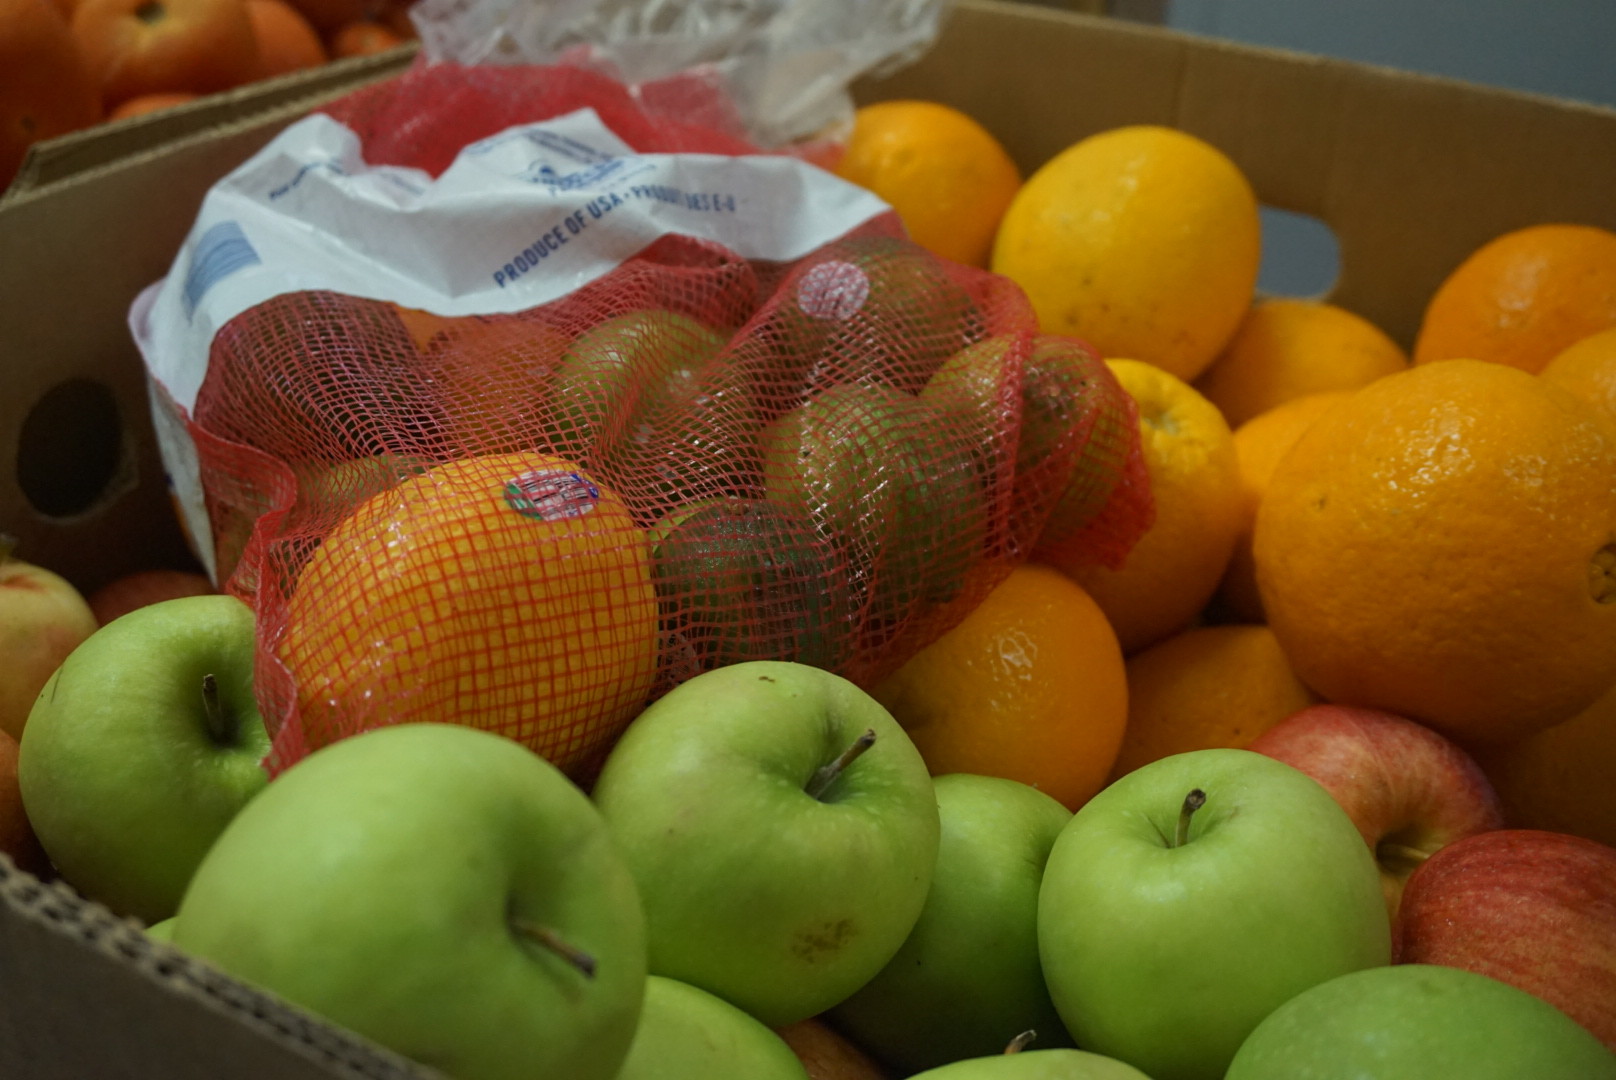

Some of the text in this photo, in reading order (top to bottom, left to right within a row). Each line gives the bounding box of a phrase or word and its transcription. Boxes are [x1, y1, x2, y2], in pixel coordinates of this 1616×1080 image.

[492, 225, 569, 289] PRODUCE
[564, 208, 588, 236] OF
[586, 190, 625, 220] USA
